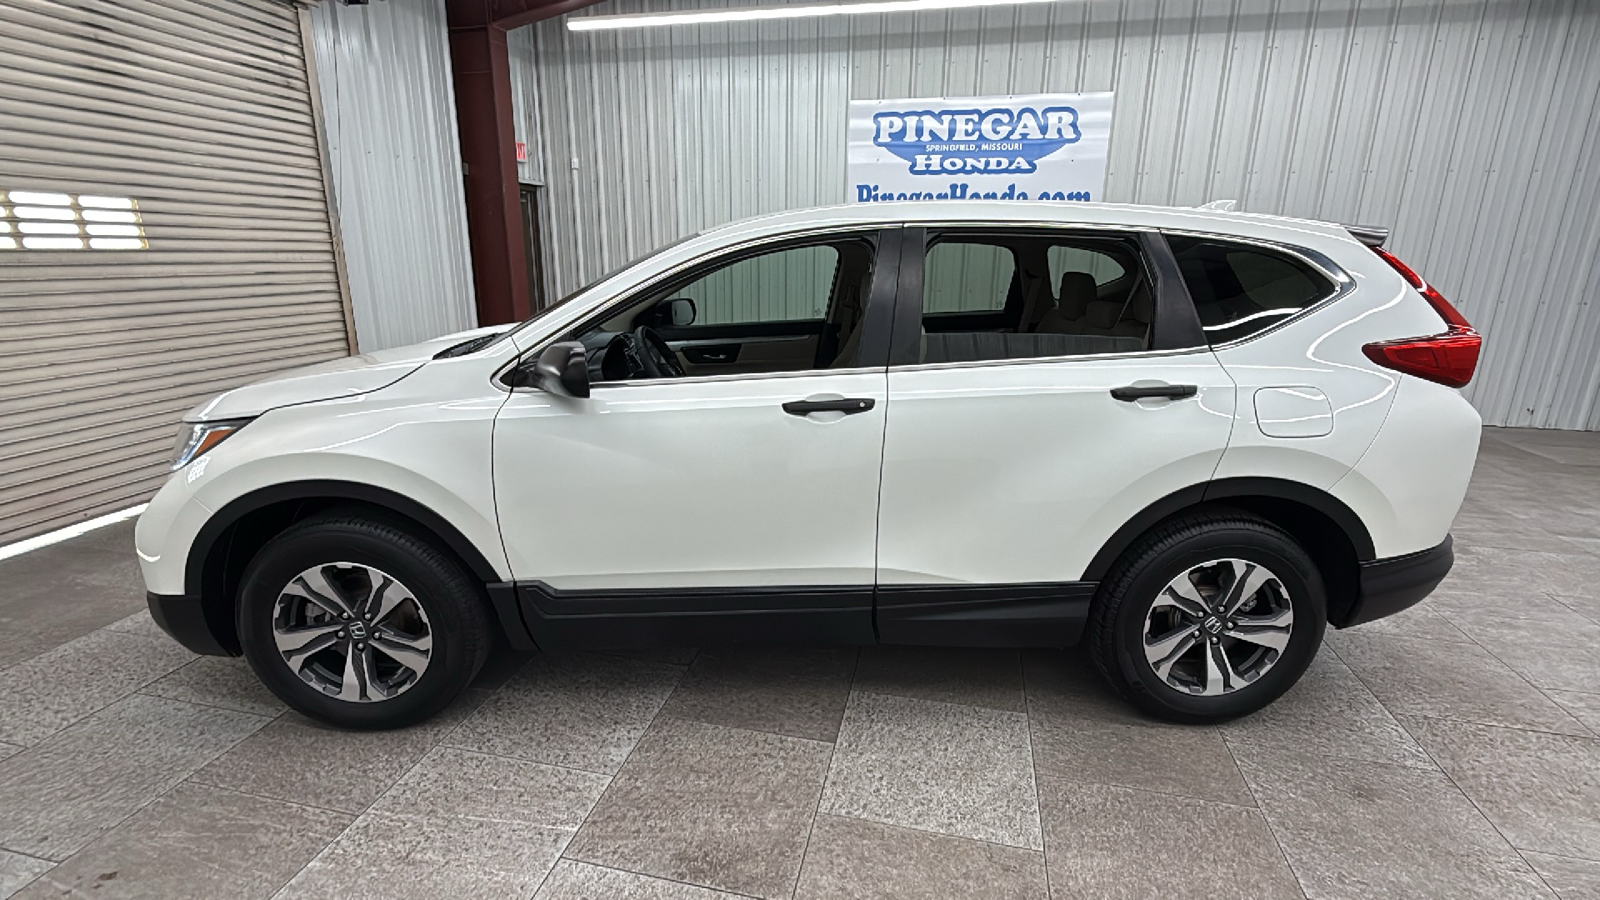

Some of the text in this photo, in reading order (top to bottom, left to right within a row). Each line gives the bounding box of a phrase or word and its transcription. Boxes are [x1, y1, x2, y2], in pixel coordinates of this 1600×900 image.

[876, 111, 1077, 143] PINEGAR
[925, 142, 1023, 152] SPRINGFIELD, MISSOURI
